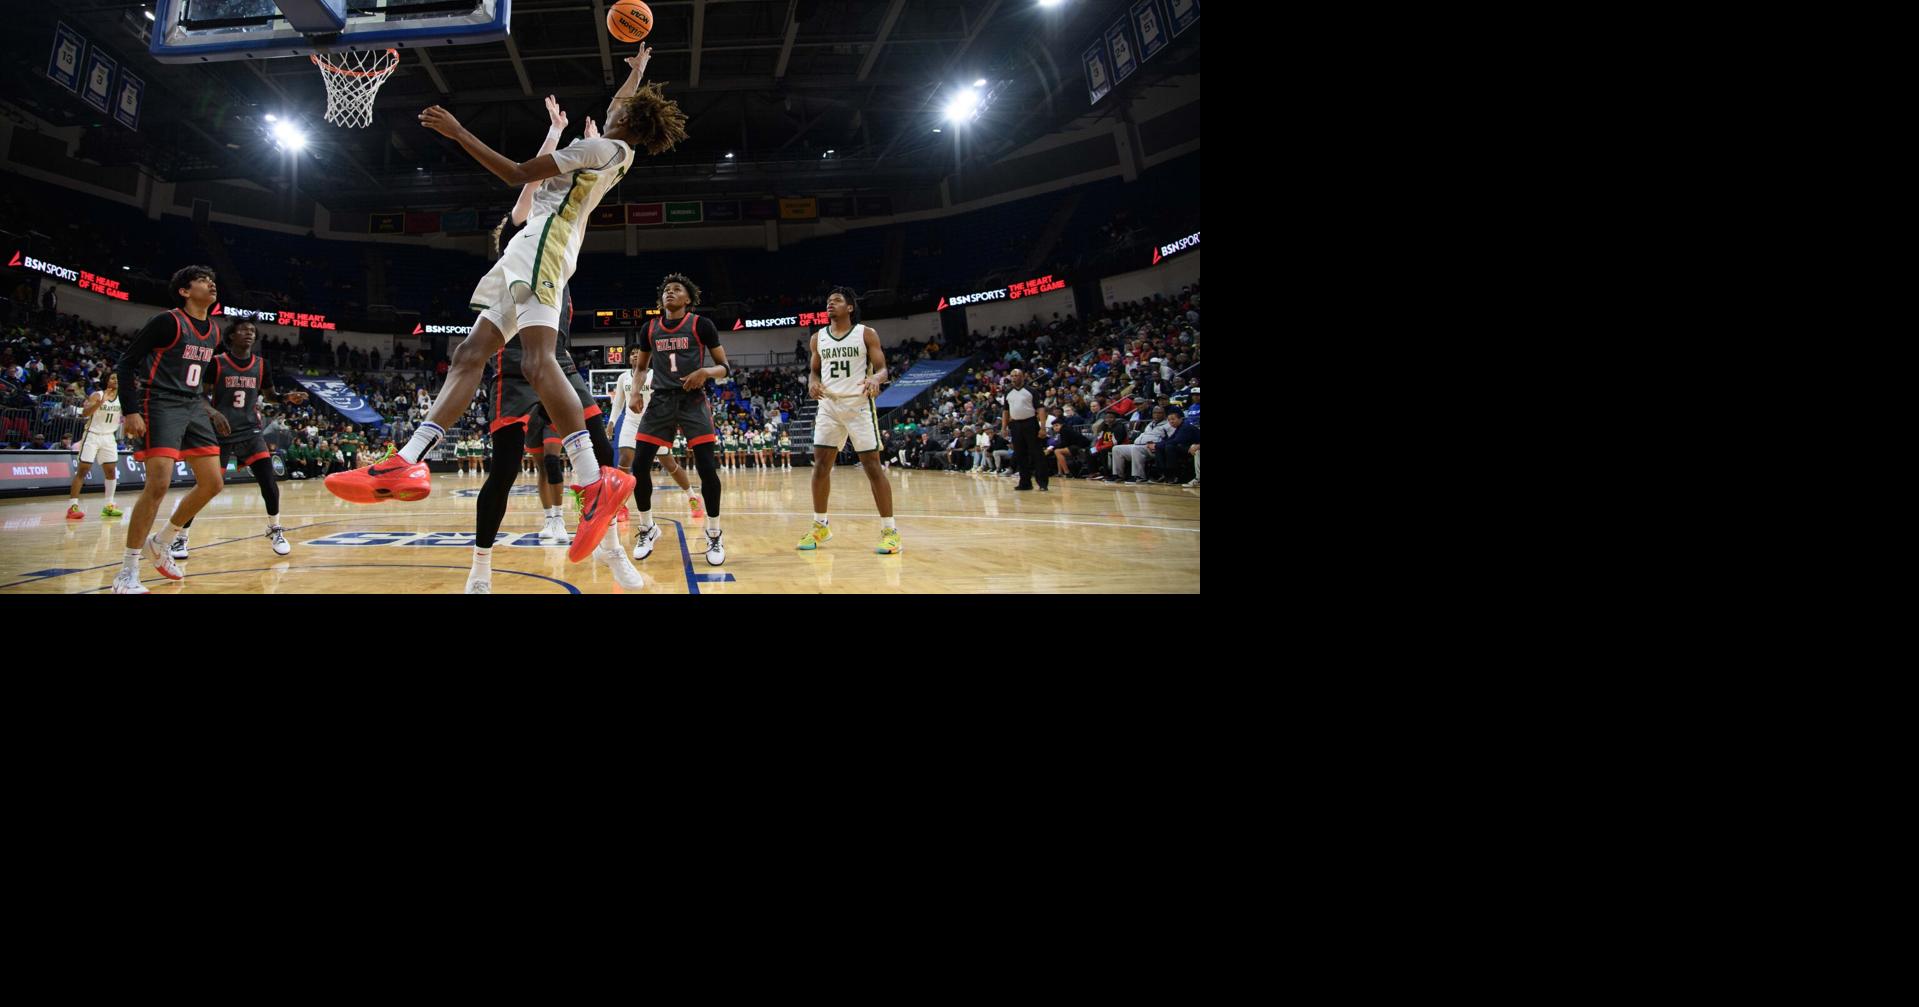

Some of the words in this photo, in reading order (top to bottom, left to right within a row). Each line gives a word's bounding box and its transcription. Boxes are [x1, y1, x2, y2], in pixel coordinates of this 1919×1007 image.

[80, 270, 95, 282] THE
[96, 275, 120, 290] HEART
[1008, 282, 1025, 292] THE
[1026, 275, 1053, 289] HEART
[78, 279, 90, 289] OF
[91, 283, 105, 294] THE
[106, 287, 129, 300] GAME
[1009, 291, 1022, 299] OF
[1023, 287, 1039, 296] THE
[1040, 280, 1065, 292] GAME
[278, 311, 296, 319] THE
[297, 312, 326, 322] HEART
[799, 312, 815, 320] THE
[799, 319, 813, 327] OF
[814, 318, 830, 326] THE
[278, 318, 290, 326] OF
[292, 319, 309, 328] THE
[311, 321, 337, 330] GAME
[655, 337, 689, 351] MILTON
[821, 346, 859, 360] GRAYSON
[669, 353, 678, 372] 1
[830, 360, 851, 378] 24
[186, 363, 202, 387] 0
[225, 376, 257, 388] MILTON
[233, 390, 246, 408] 3
[105, 413, 113, 423] 11
[12, 466, 49, 476] MILTON
